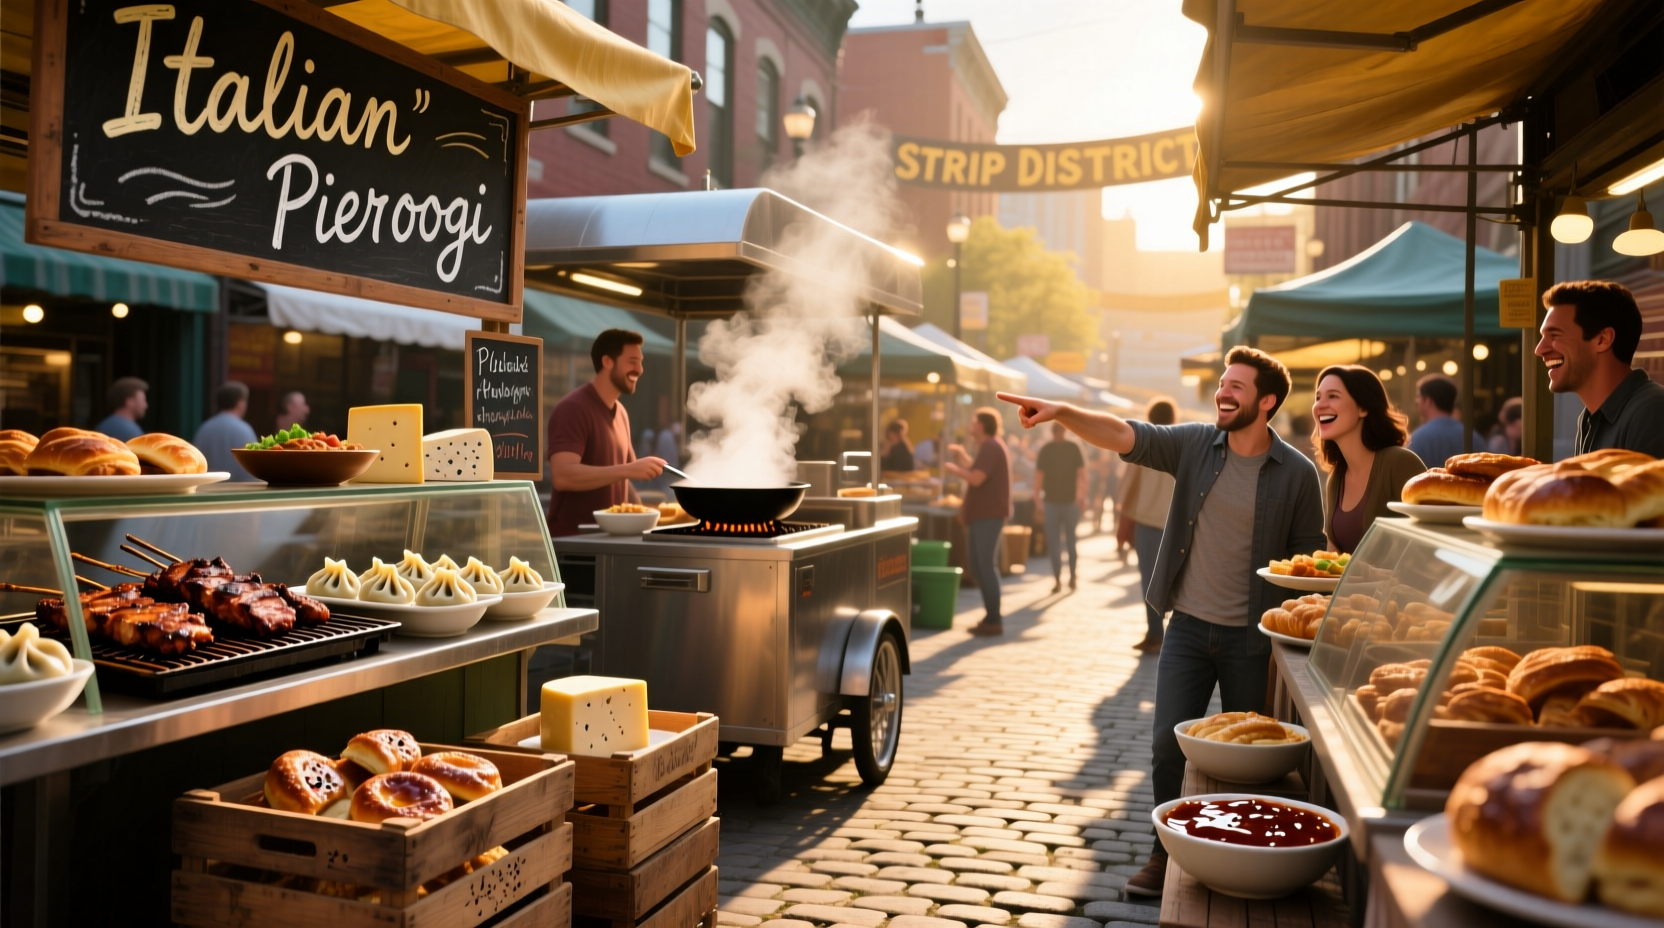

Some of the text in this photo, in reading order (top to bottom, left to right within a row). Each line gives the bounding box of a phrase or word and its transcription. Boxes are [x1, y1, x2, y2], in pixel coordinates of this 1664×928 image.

[895, 132, 1198, 187] STRIP DISTRICT
[267, 154, 493, 283] Pieroogi
